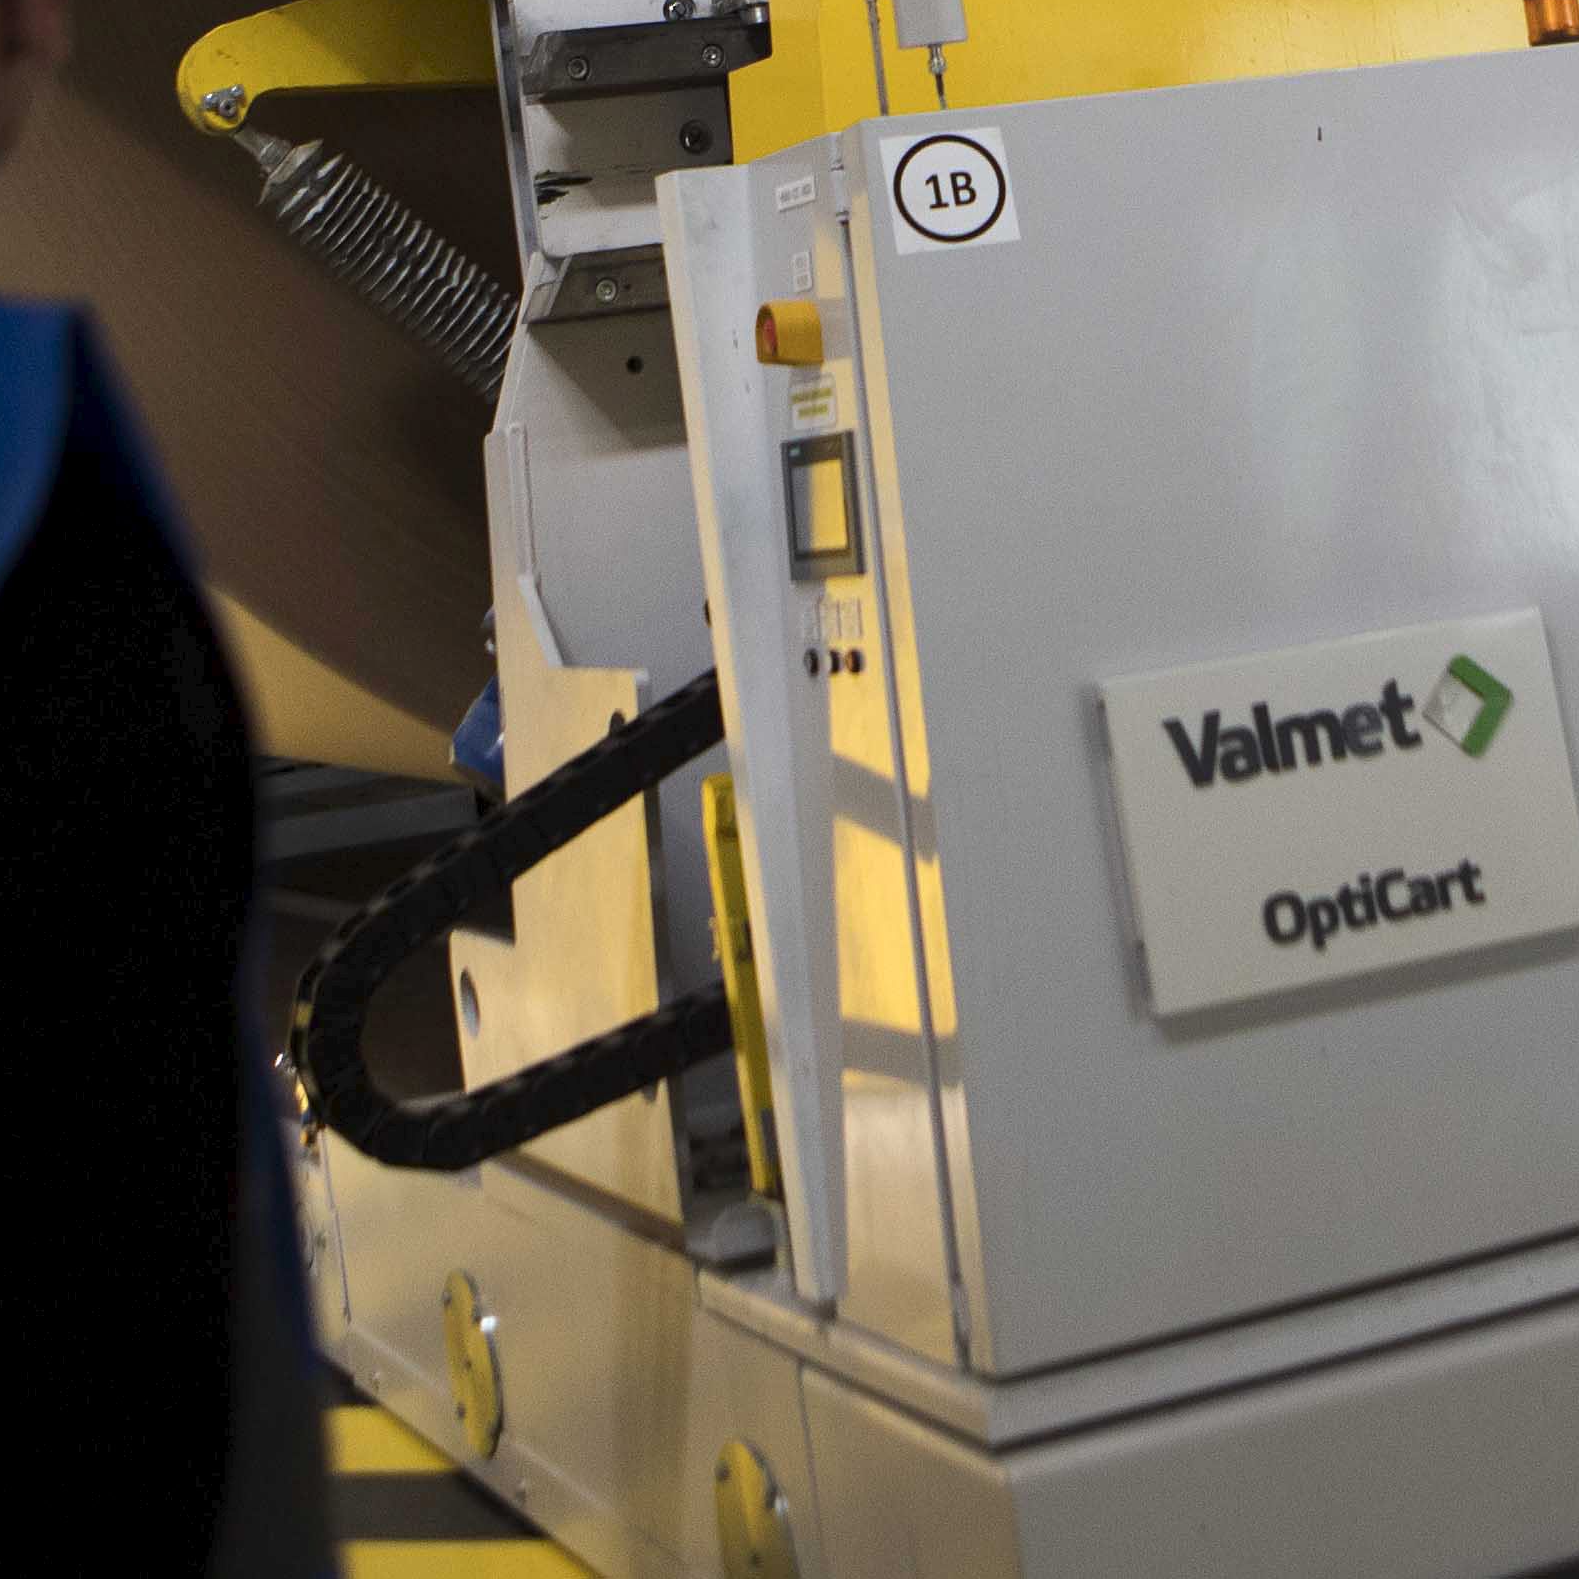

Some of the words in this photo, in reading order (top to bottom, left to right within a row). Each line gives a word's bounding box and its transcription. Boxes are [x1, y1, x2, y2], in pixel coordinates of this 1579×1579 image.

[923, 170, 979, 213] 1B
[1162, 677, 1422, 790] Valmet
[1263, 858, 1485, 952] OptiCart
